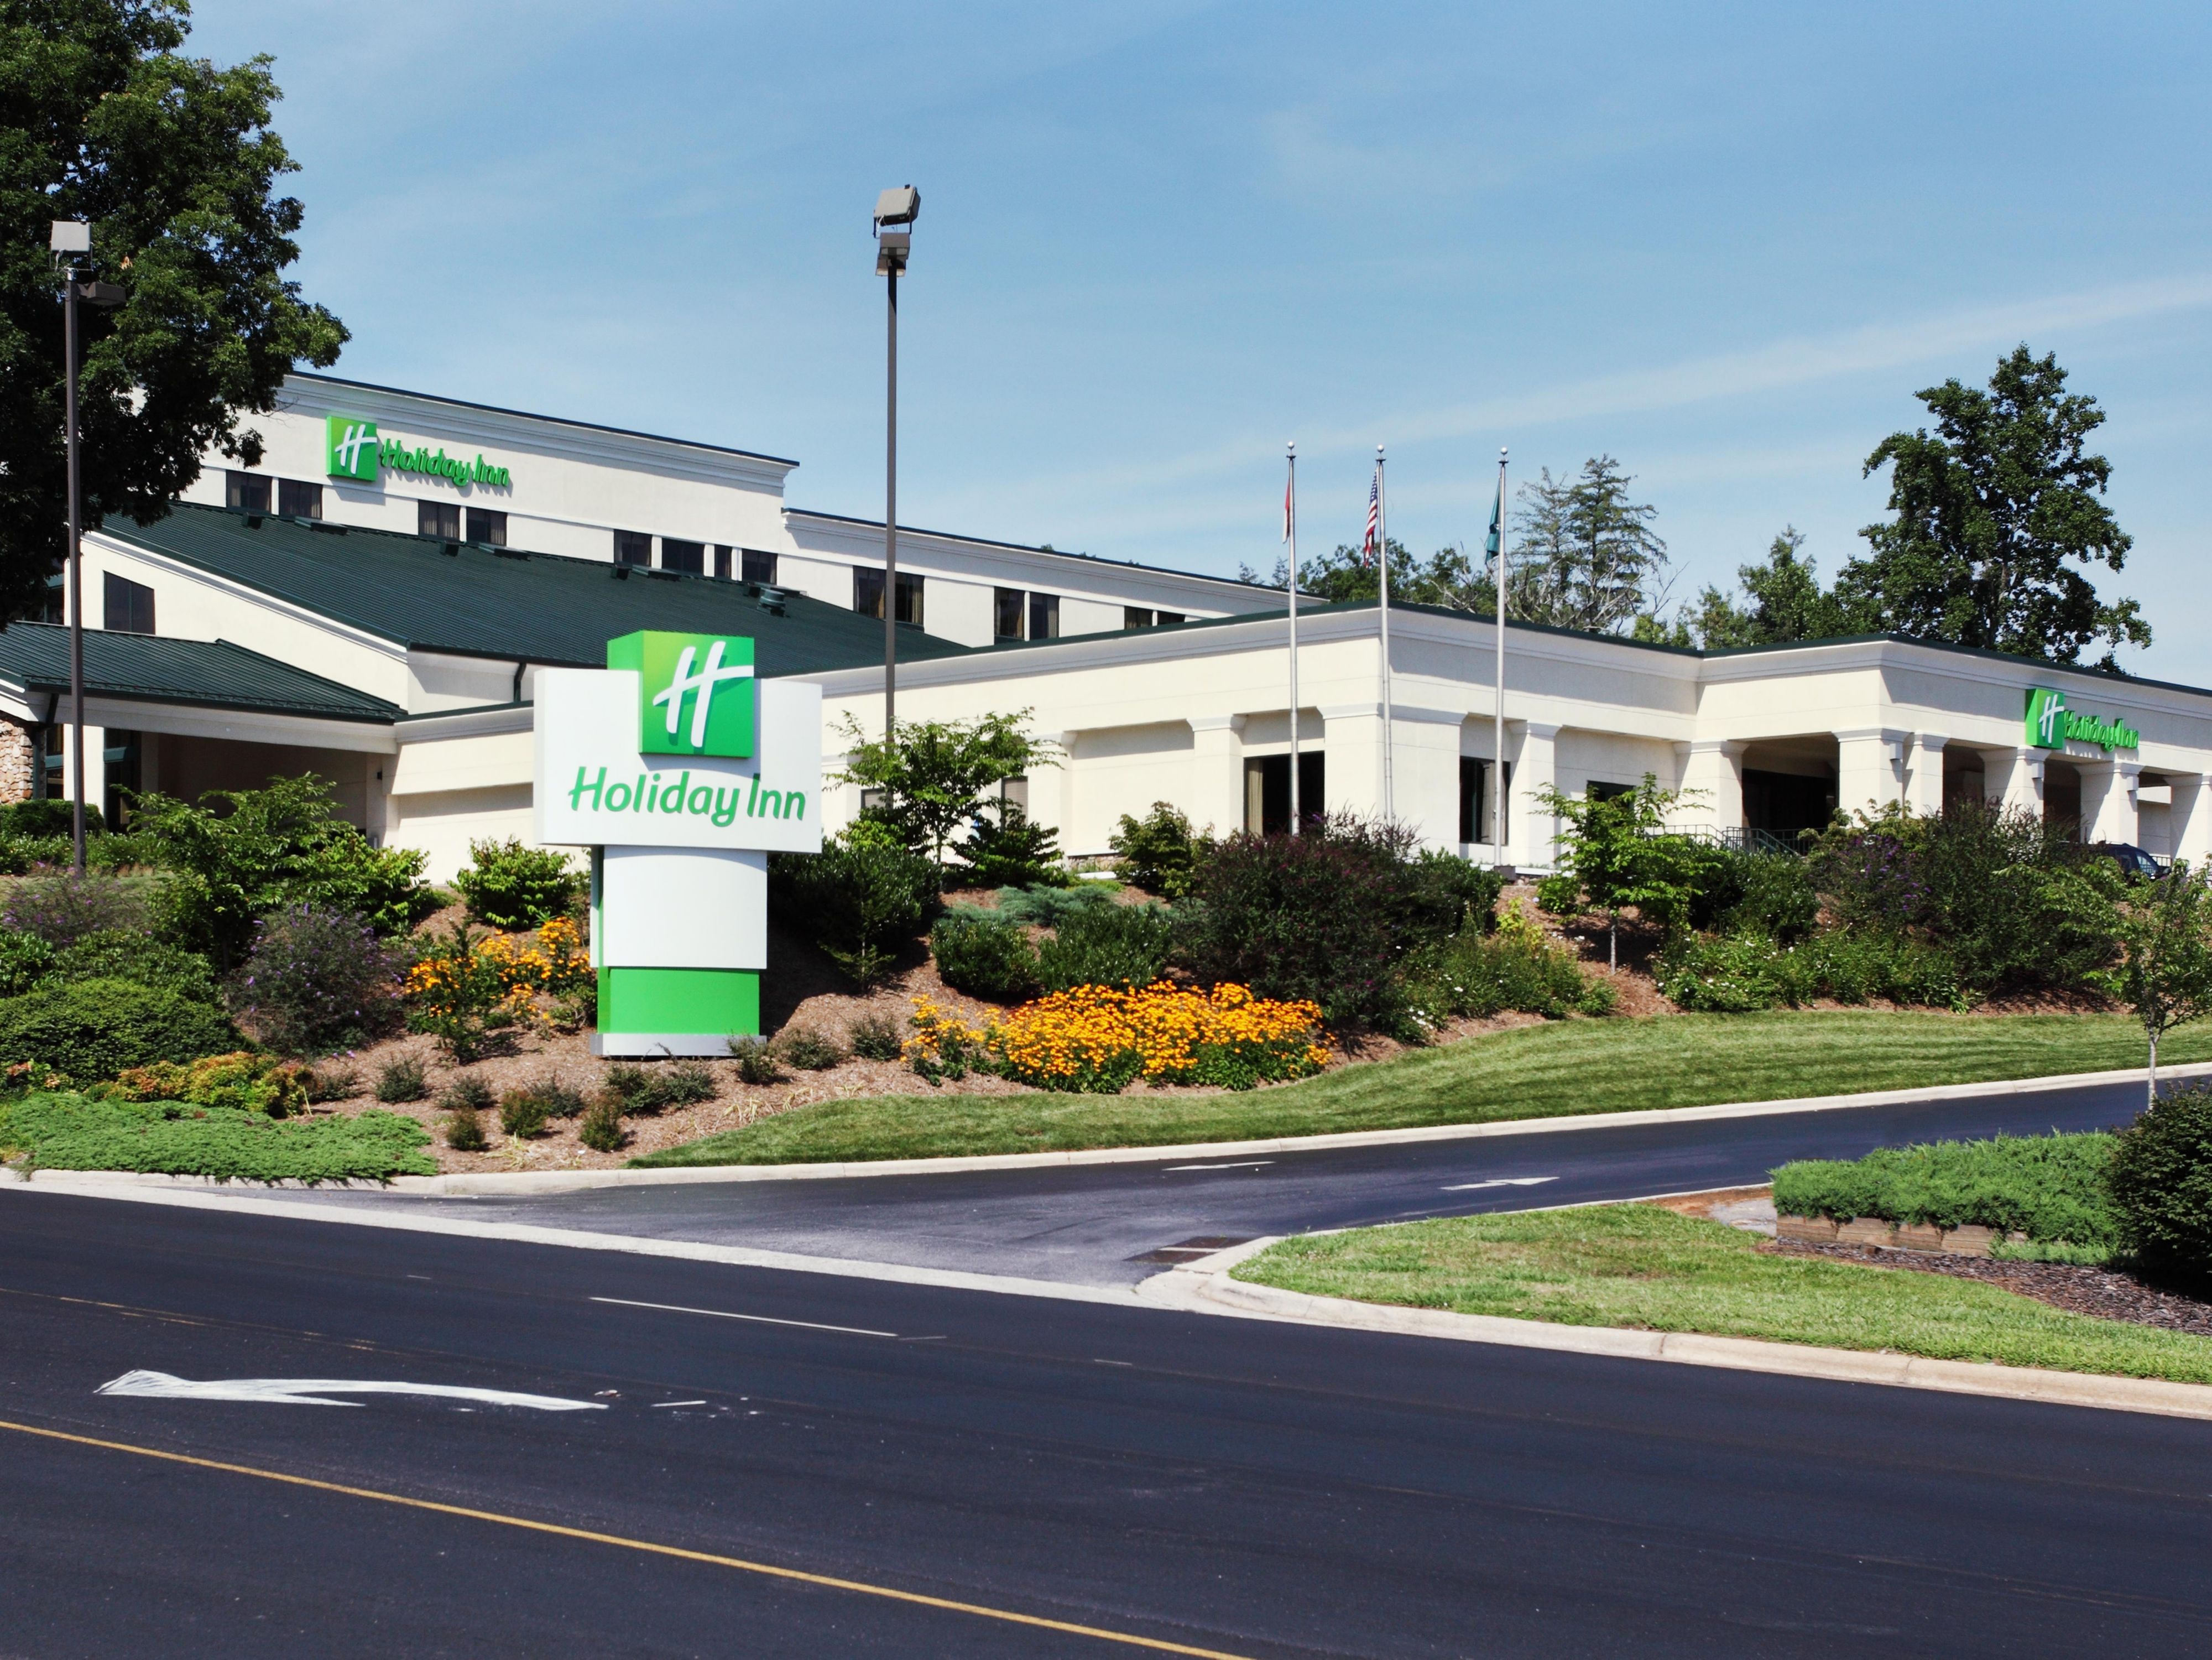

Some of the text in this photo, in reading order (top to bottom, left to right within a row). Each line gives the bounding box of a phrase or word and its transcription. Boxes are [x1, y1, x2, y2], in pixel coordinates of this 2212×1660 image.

[380, 438, 509, 487] Holiday Inn
[2064, 710, 2140, 753] Holiday Inn
[568, 766, 806, 828] Holiday Inn
